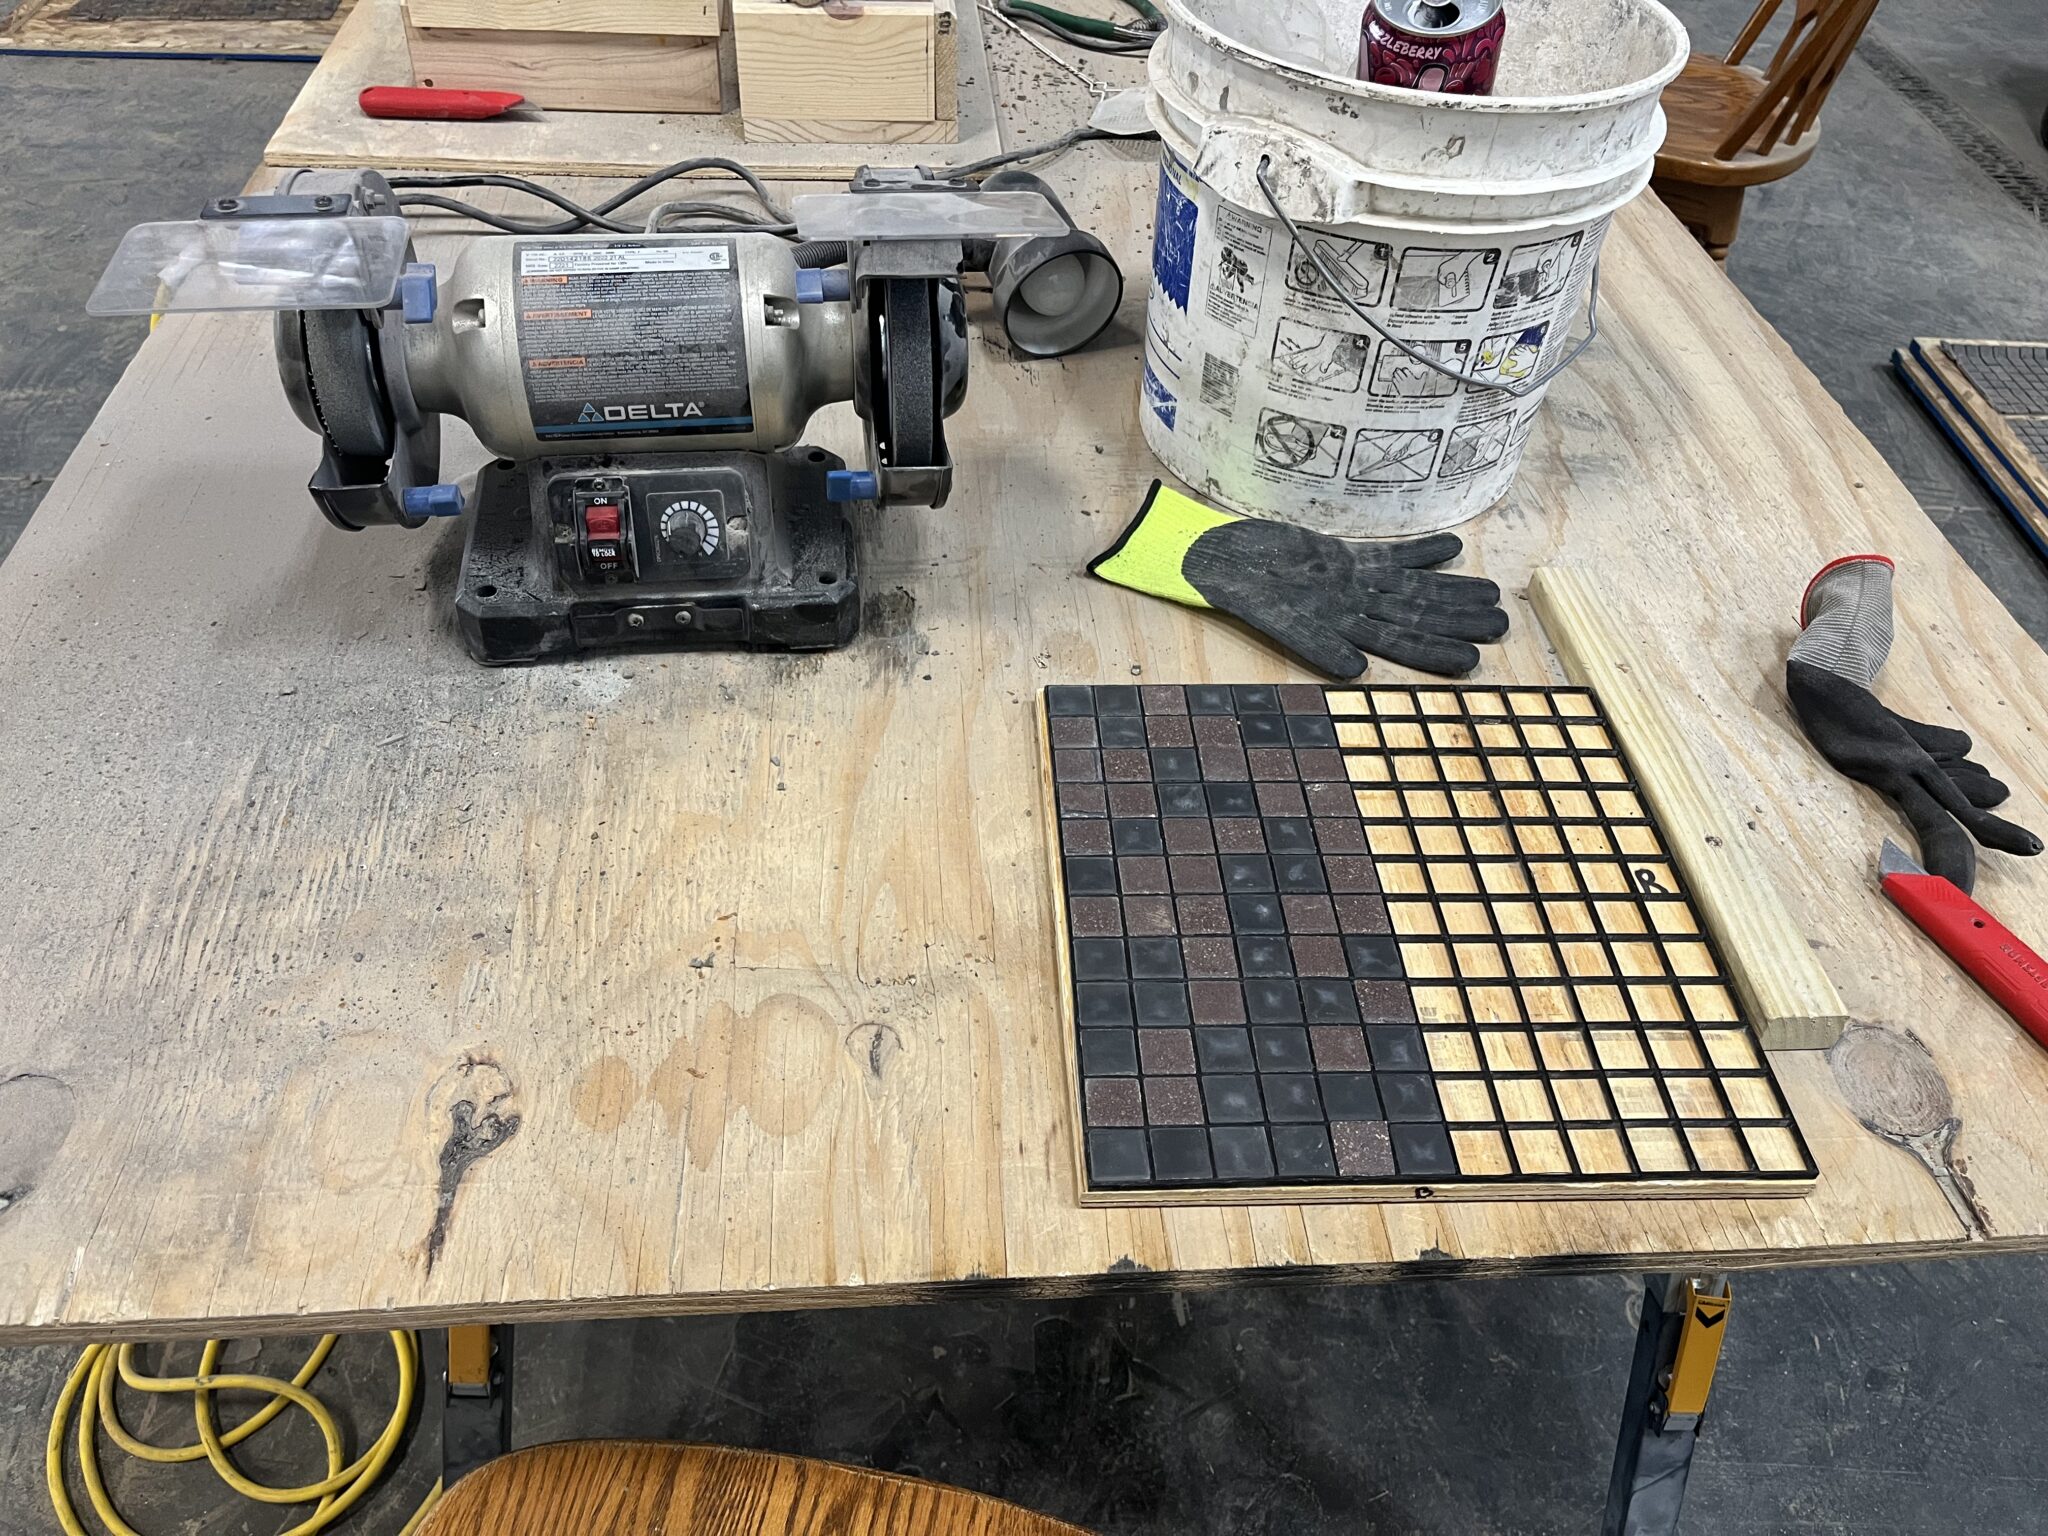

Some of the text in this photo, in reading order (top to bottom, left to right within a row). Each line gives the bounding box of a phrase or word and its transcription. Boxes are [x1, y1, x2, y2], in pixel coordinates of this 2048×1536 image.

[1369, 20, 1442, 60] ZLEBERRY
[1486, 253, 1494, 262] 2
[1215, 284, 1259, 310] AERTENCIA
[1459, 343, 1467, 351] 5
[603, 402, 703, 421] DELTA
[593, 497, 608, 505] ON
[600, 562, 618, 570] OFF
[1634, 868, 1670, 894] R
